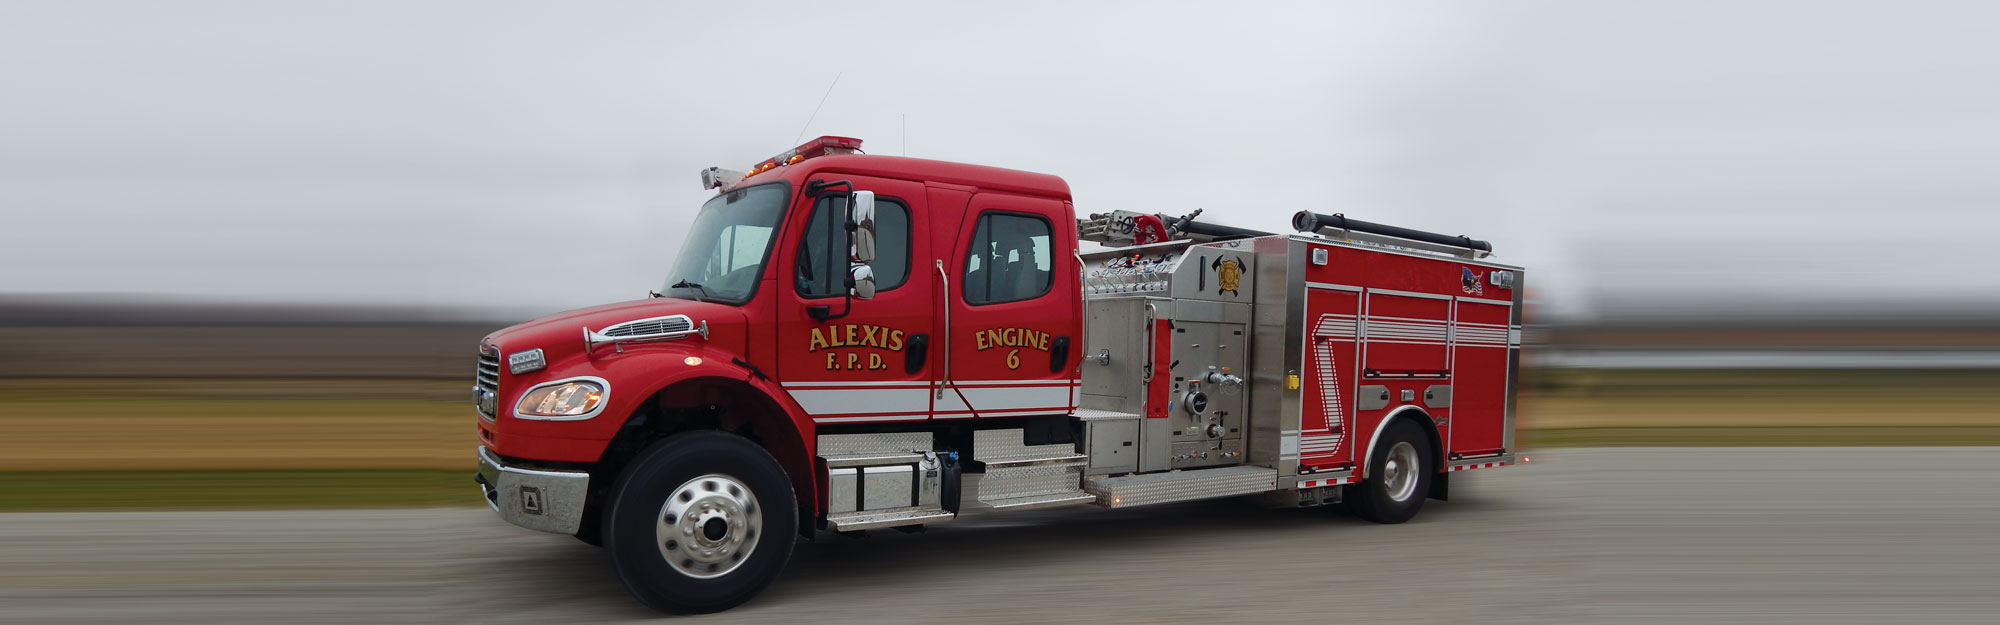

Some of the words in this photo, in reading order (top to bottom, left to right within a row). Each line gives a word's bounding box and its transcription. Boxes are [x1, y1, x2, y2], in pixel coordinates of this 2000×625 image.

[809, 324, 904, 351] ALEXIS
[975, 327, 1050, 351] ENGINE
[1006, 349, 1020, 370] 6
